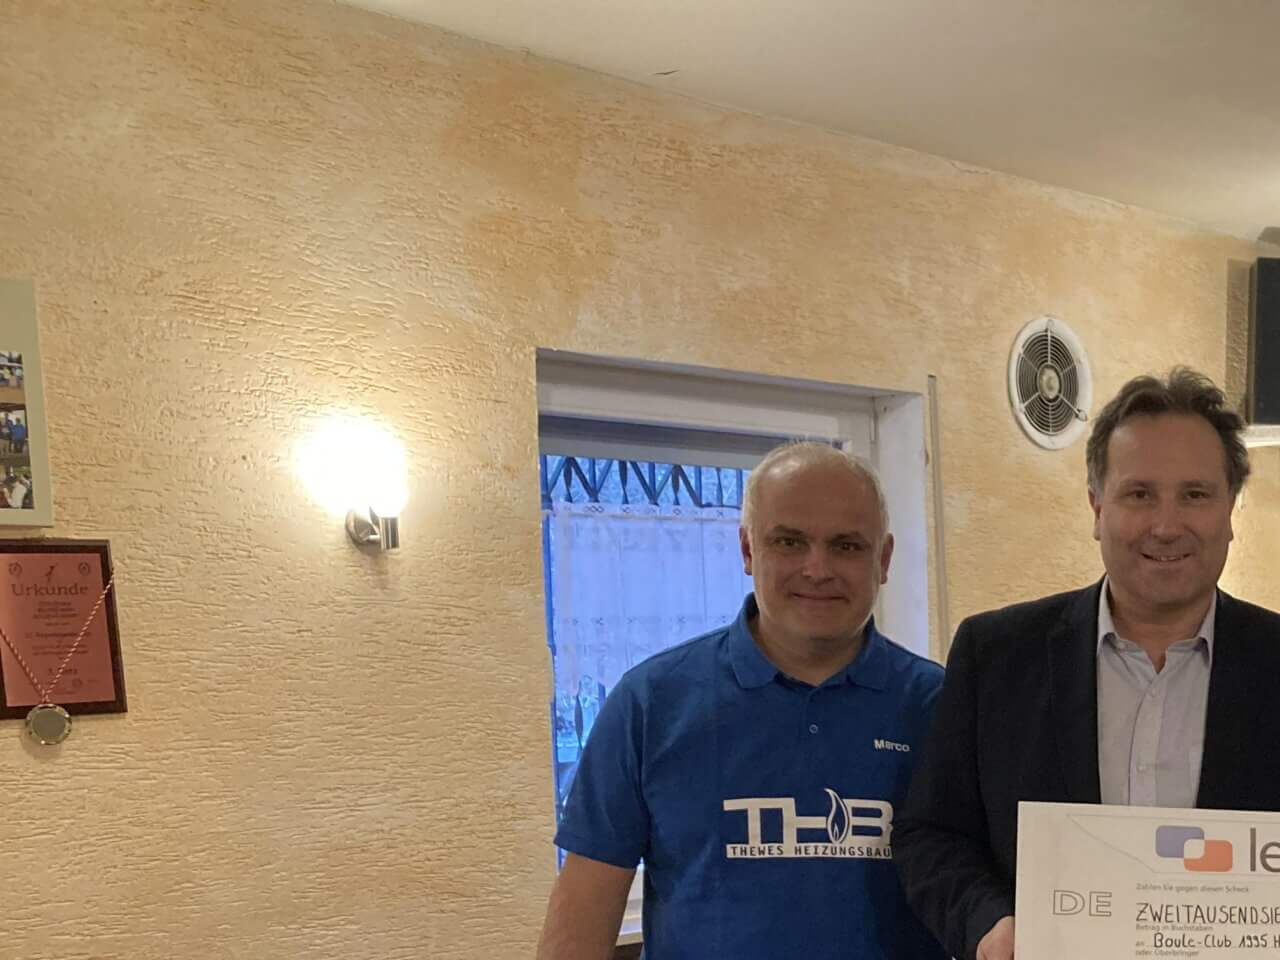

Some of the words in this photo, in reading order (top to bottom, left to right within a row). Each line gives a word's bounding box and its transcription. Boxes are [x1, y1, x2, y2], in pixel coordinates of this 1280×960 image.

[11, 583, 89, 597] Urkunde
[873, 738, 911, 752] Marco
[730, 844, 784, 857] THEWES
[793, 845, 892, 858] HEIZUNGSBAU
[1053, 889, 1113, 917] DE
[1153, 932, 1232, 949] Boule-Club
[1238, 933, 1269, 949] 1995
